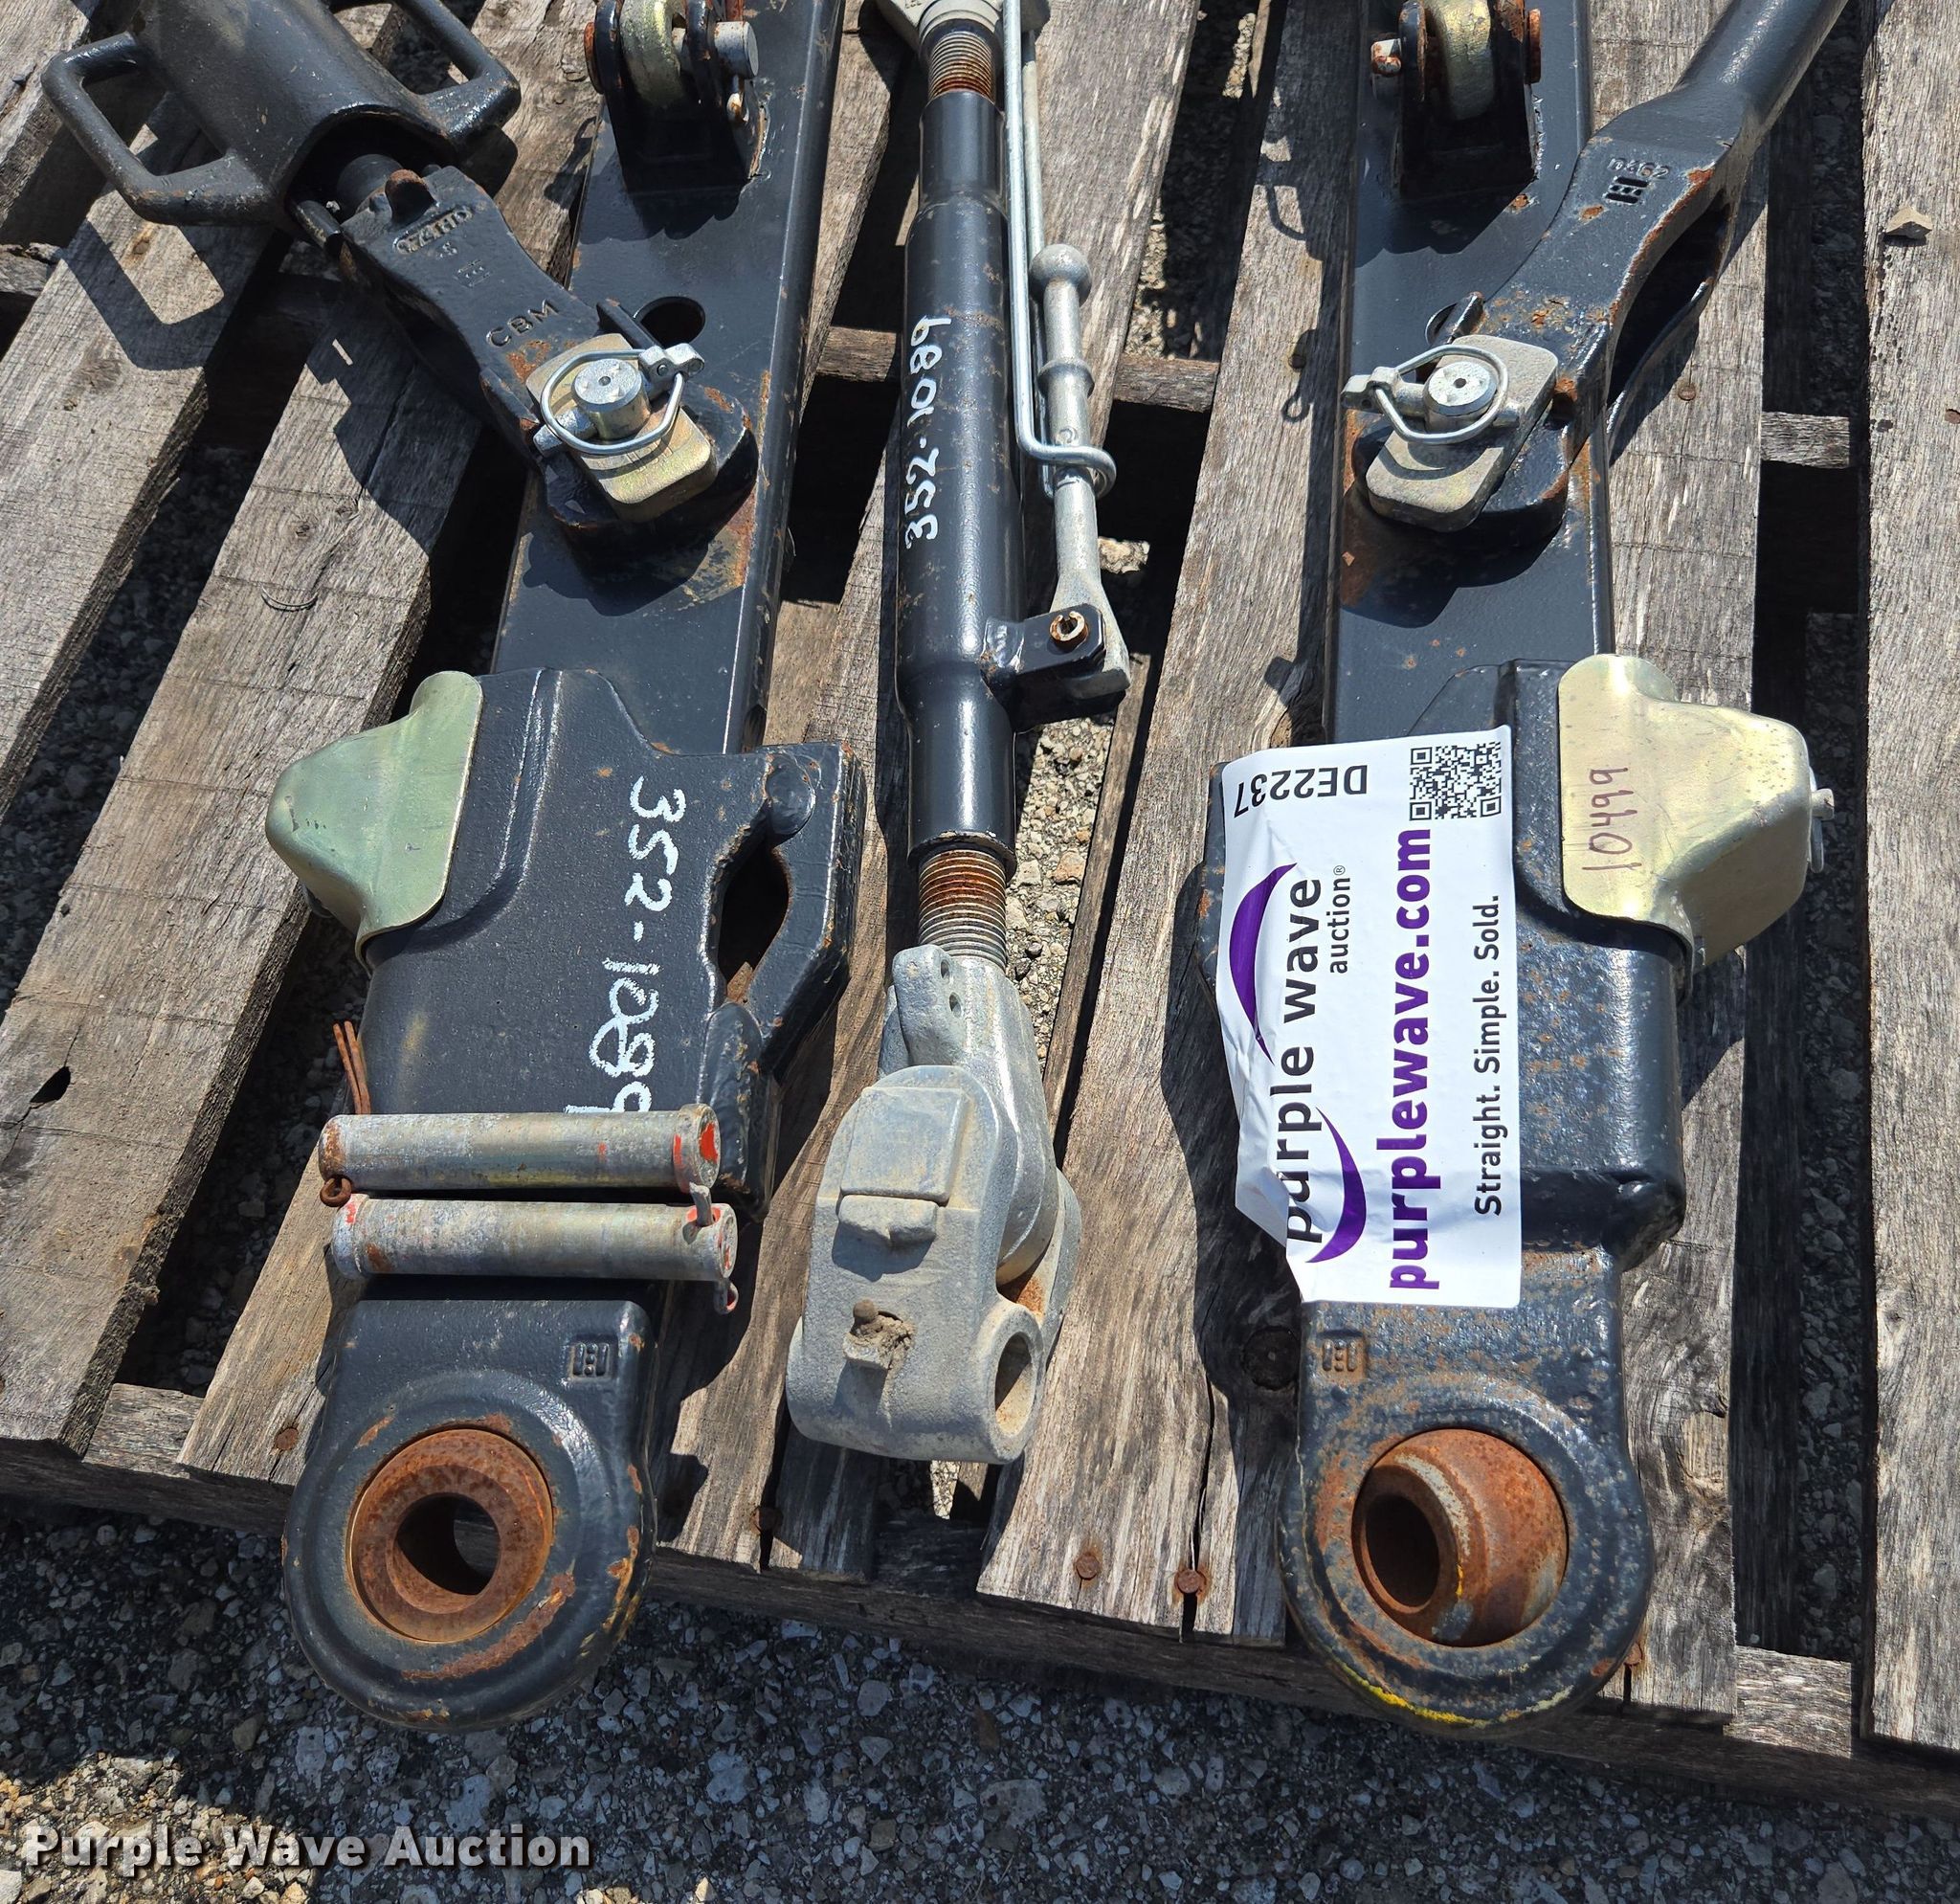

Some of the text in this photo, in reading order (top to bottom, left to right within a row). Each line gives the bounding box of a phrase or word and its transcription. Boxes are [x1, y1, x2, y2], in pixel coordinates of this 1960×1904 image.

[486, 299, 559, 347] CBM
[1234, 764, 1369, 819] DE2237
[1581, 767, 1642, 871] 10499
[1269, 876, 1323, 1243] purple wave
[1375, 829, 1441, 1290] purplewave.com
[1472, 895, 1509, 1217] Straight. Simple. Sold.
